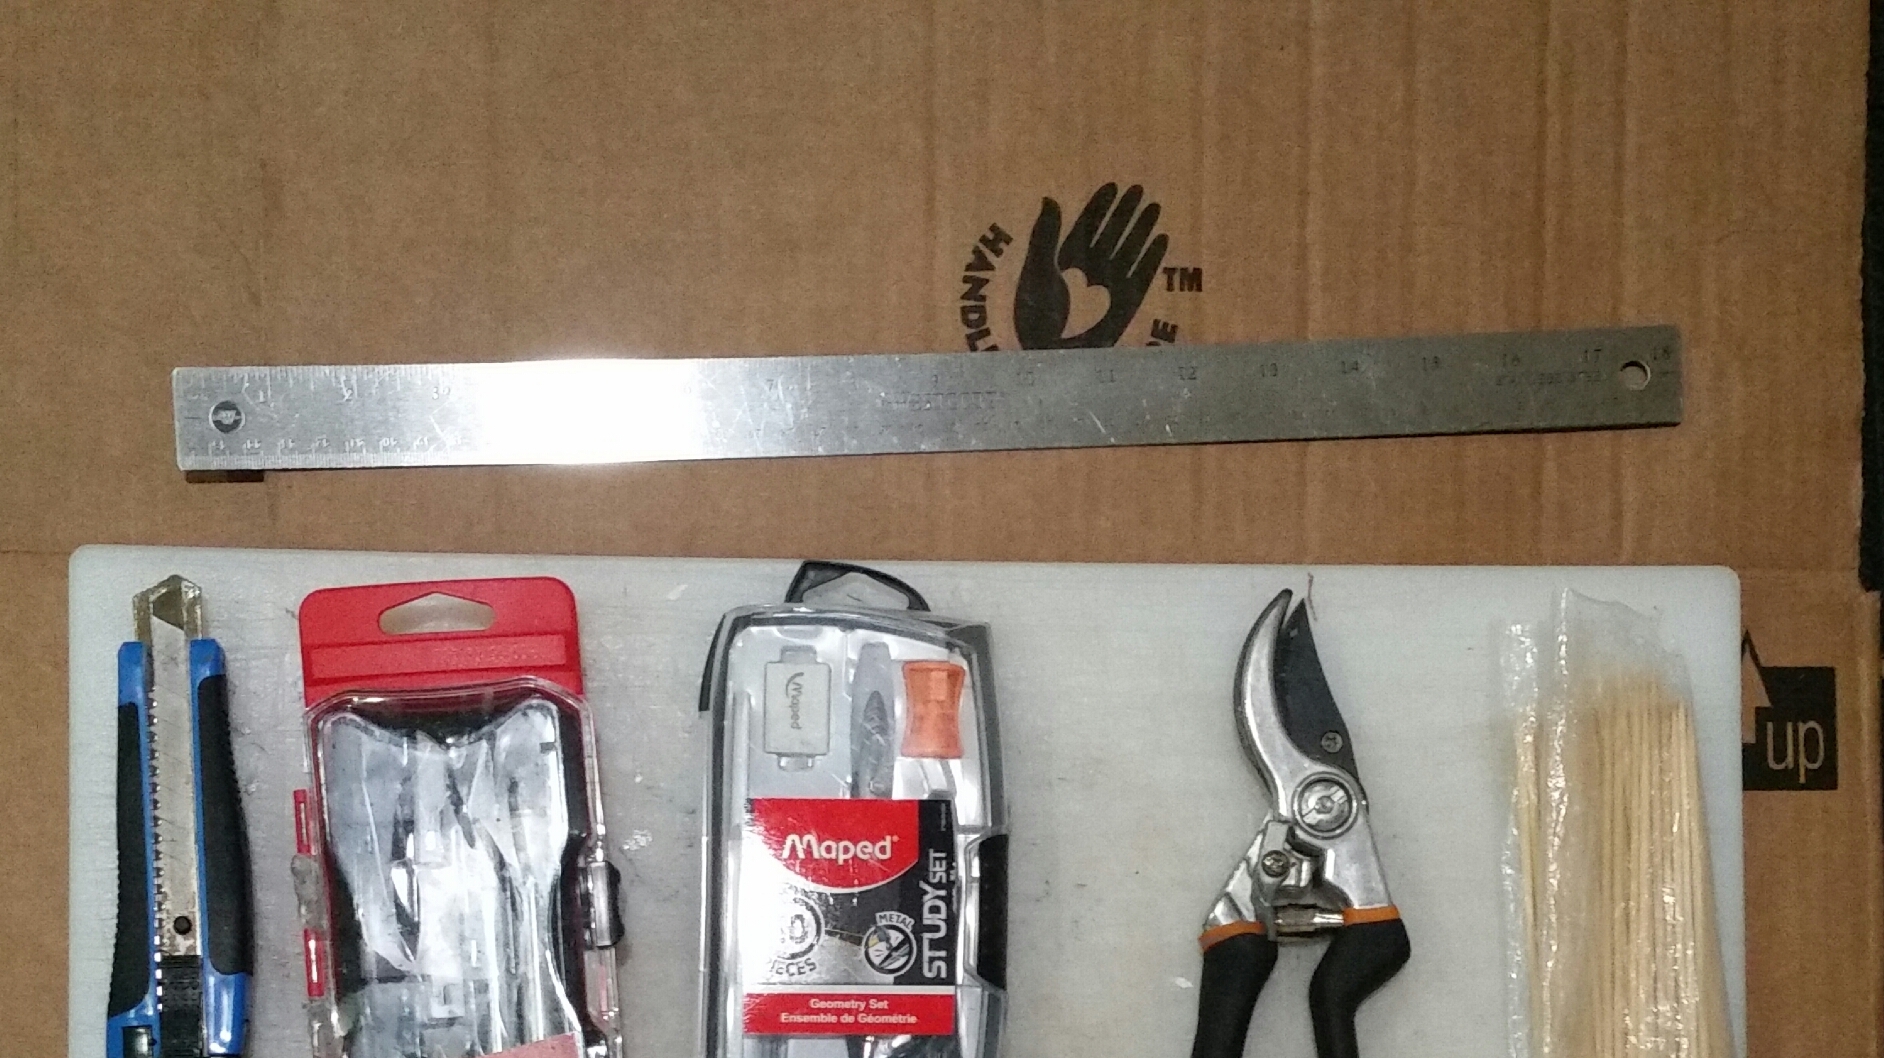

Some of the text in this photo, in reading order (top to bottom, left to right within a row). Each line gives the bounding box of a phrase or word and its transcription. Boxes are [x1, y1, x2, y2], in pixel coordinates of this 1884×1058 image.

[960, 222, 1013, 351] HANDL
[1162, 267, 1203, 292] TM
[788, 682, 803, 730] Maped
[1766, 720, 1825, 784] up
[782, 834, 893, 865] Maped
[878, 912, 914, 930] METAL
[920, 849, 947, 979] STUDY SET
[771, 957, 817, 977] IECES
[781, 1012, 918, 1025] Ensemble de Géométrie
[809, 998, 889, 1012] Geometry Set
